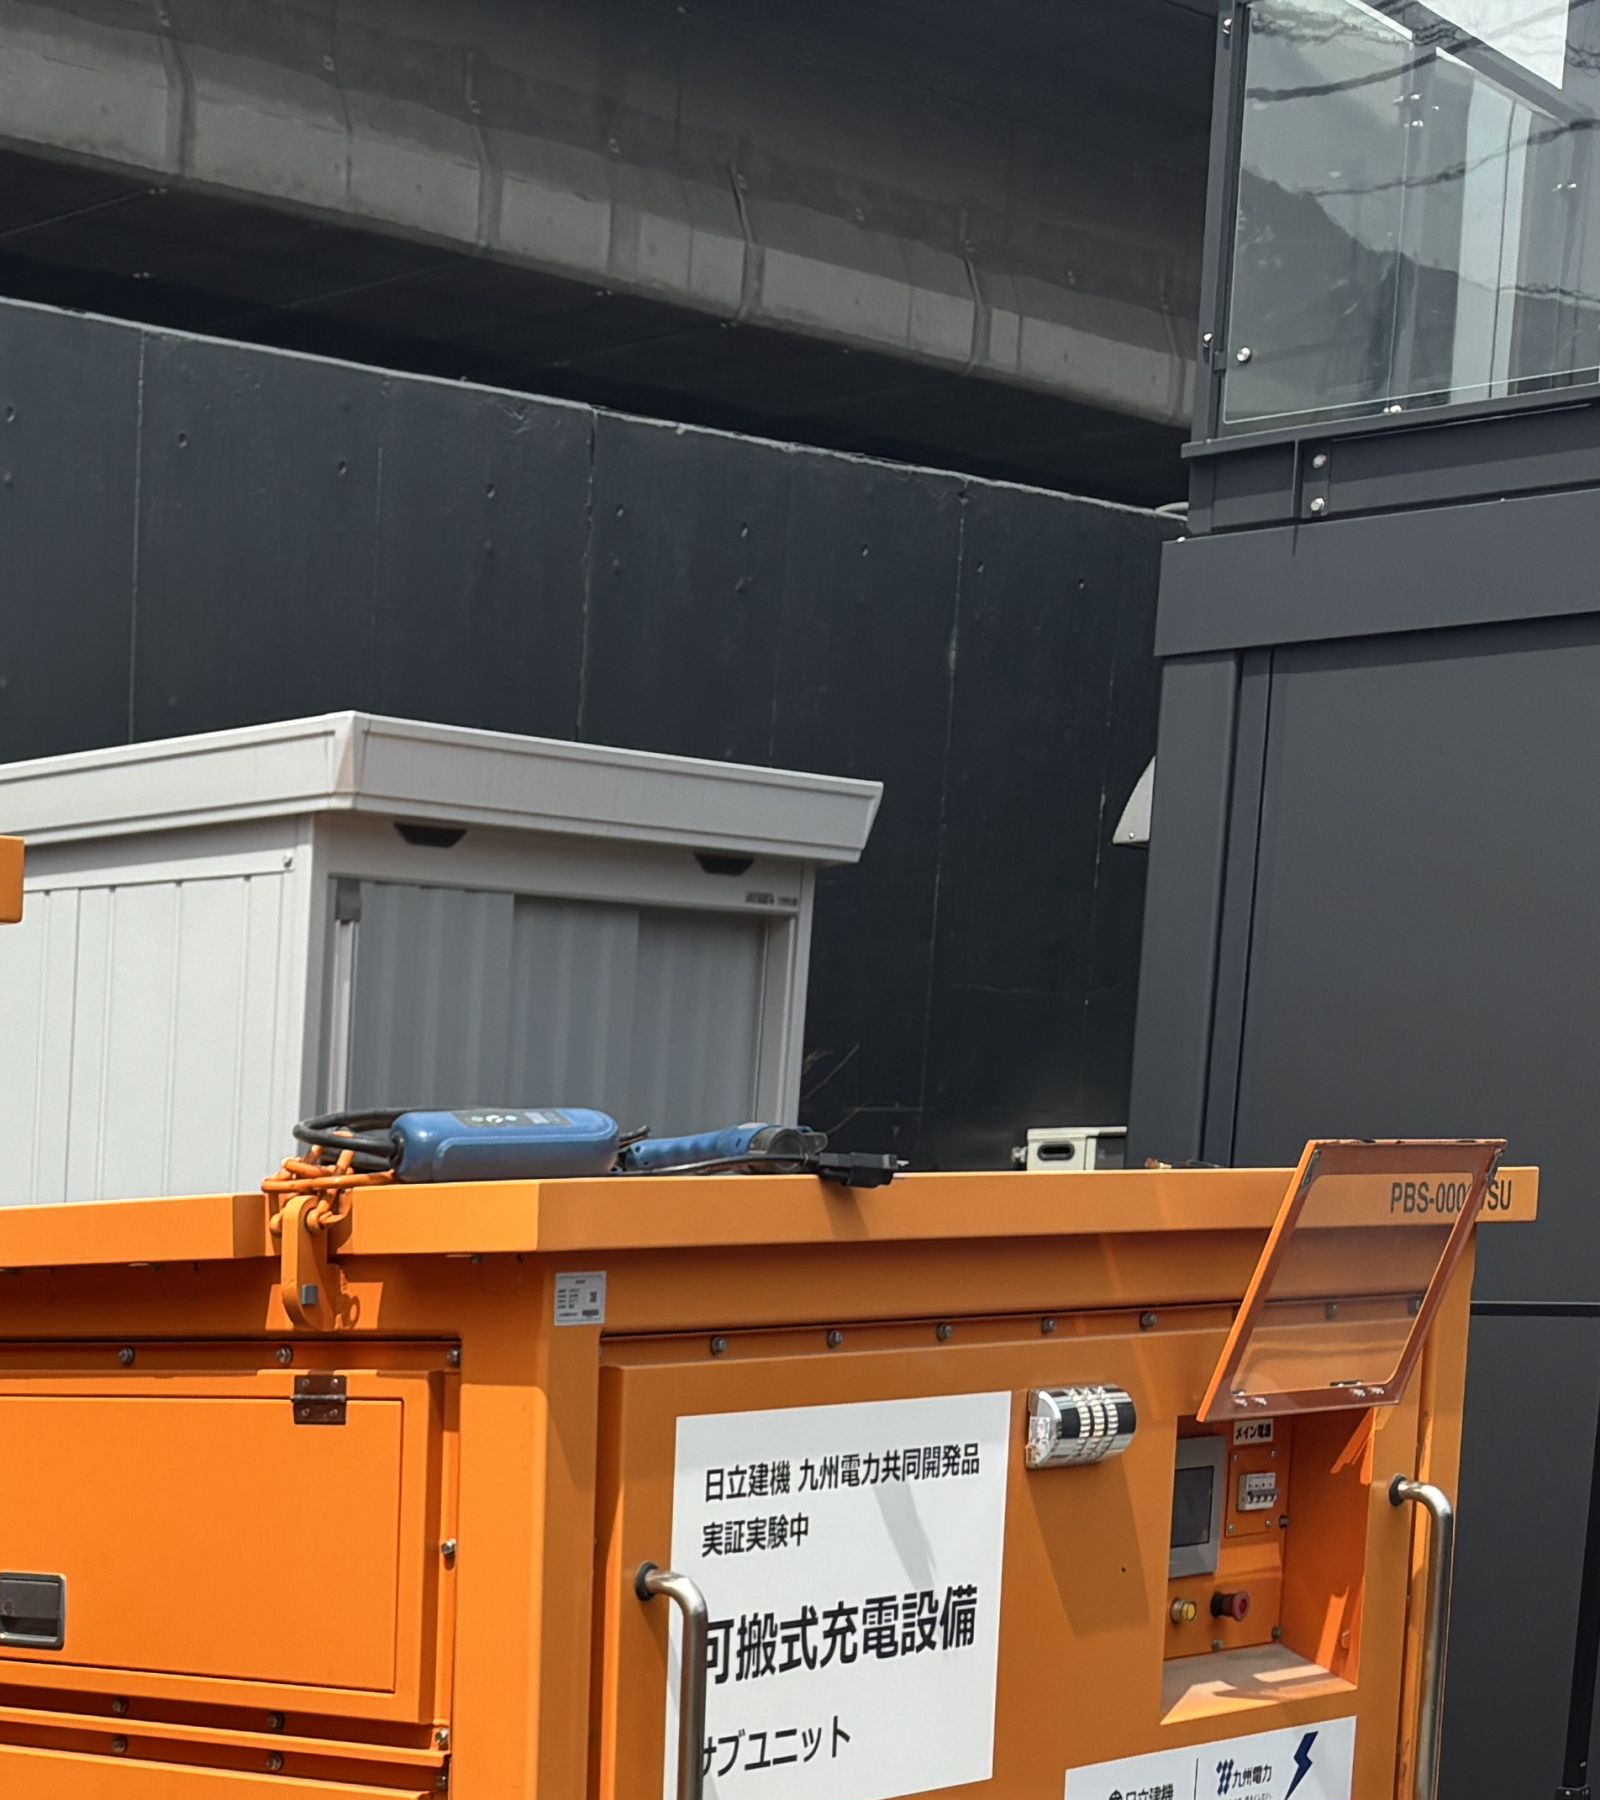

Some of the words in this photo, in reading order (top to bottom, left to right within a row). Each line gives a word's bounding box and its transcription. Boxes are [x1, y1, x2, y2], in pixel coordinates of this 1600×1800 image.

[706, 1461, 790, 1502] 日立建機
[798, 1443, 980, 1492] 九州電力共同開発品
[702, 1512, 809, 1557] 実証実験中
[707, 1584, 978, 1685] 可搬式充電設備
[1232, 1764, 1272, 1788] 九州電力
